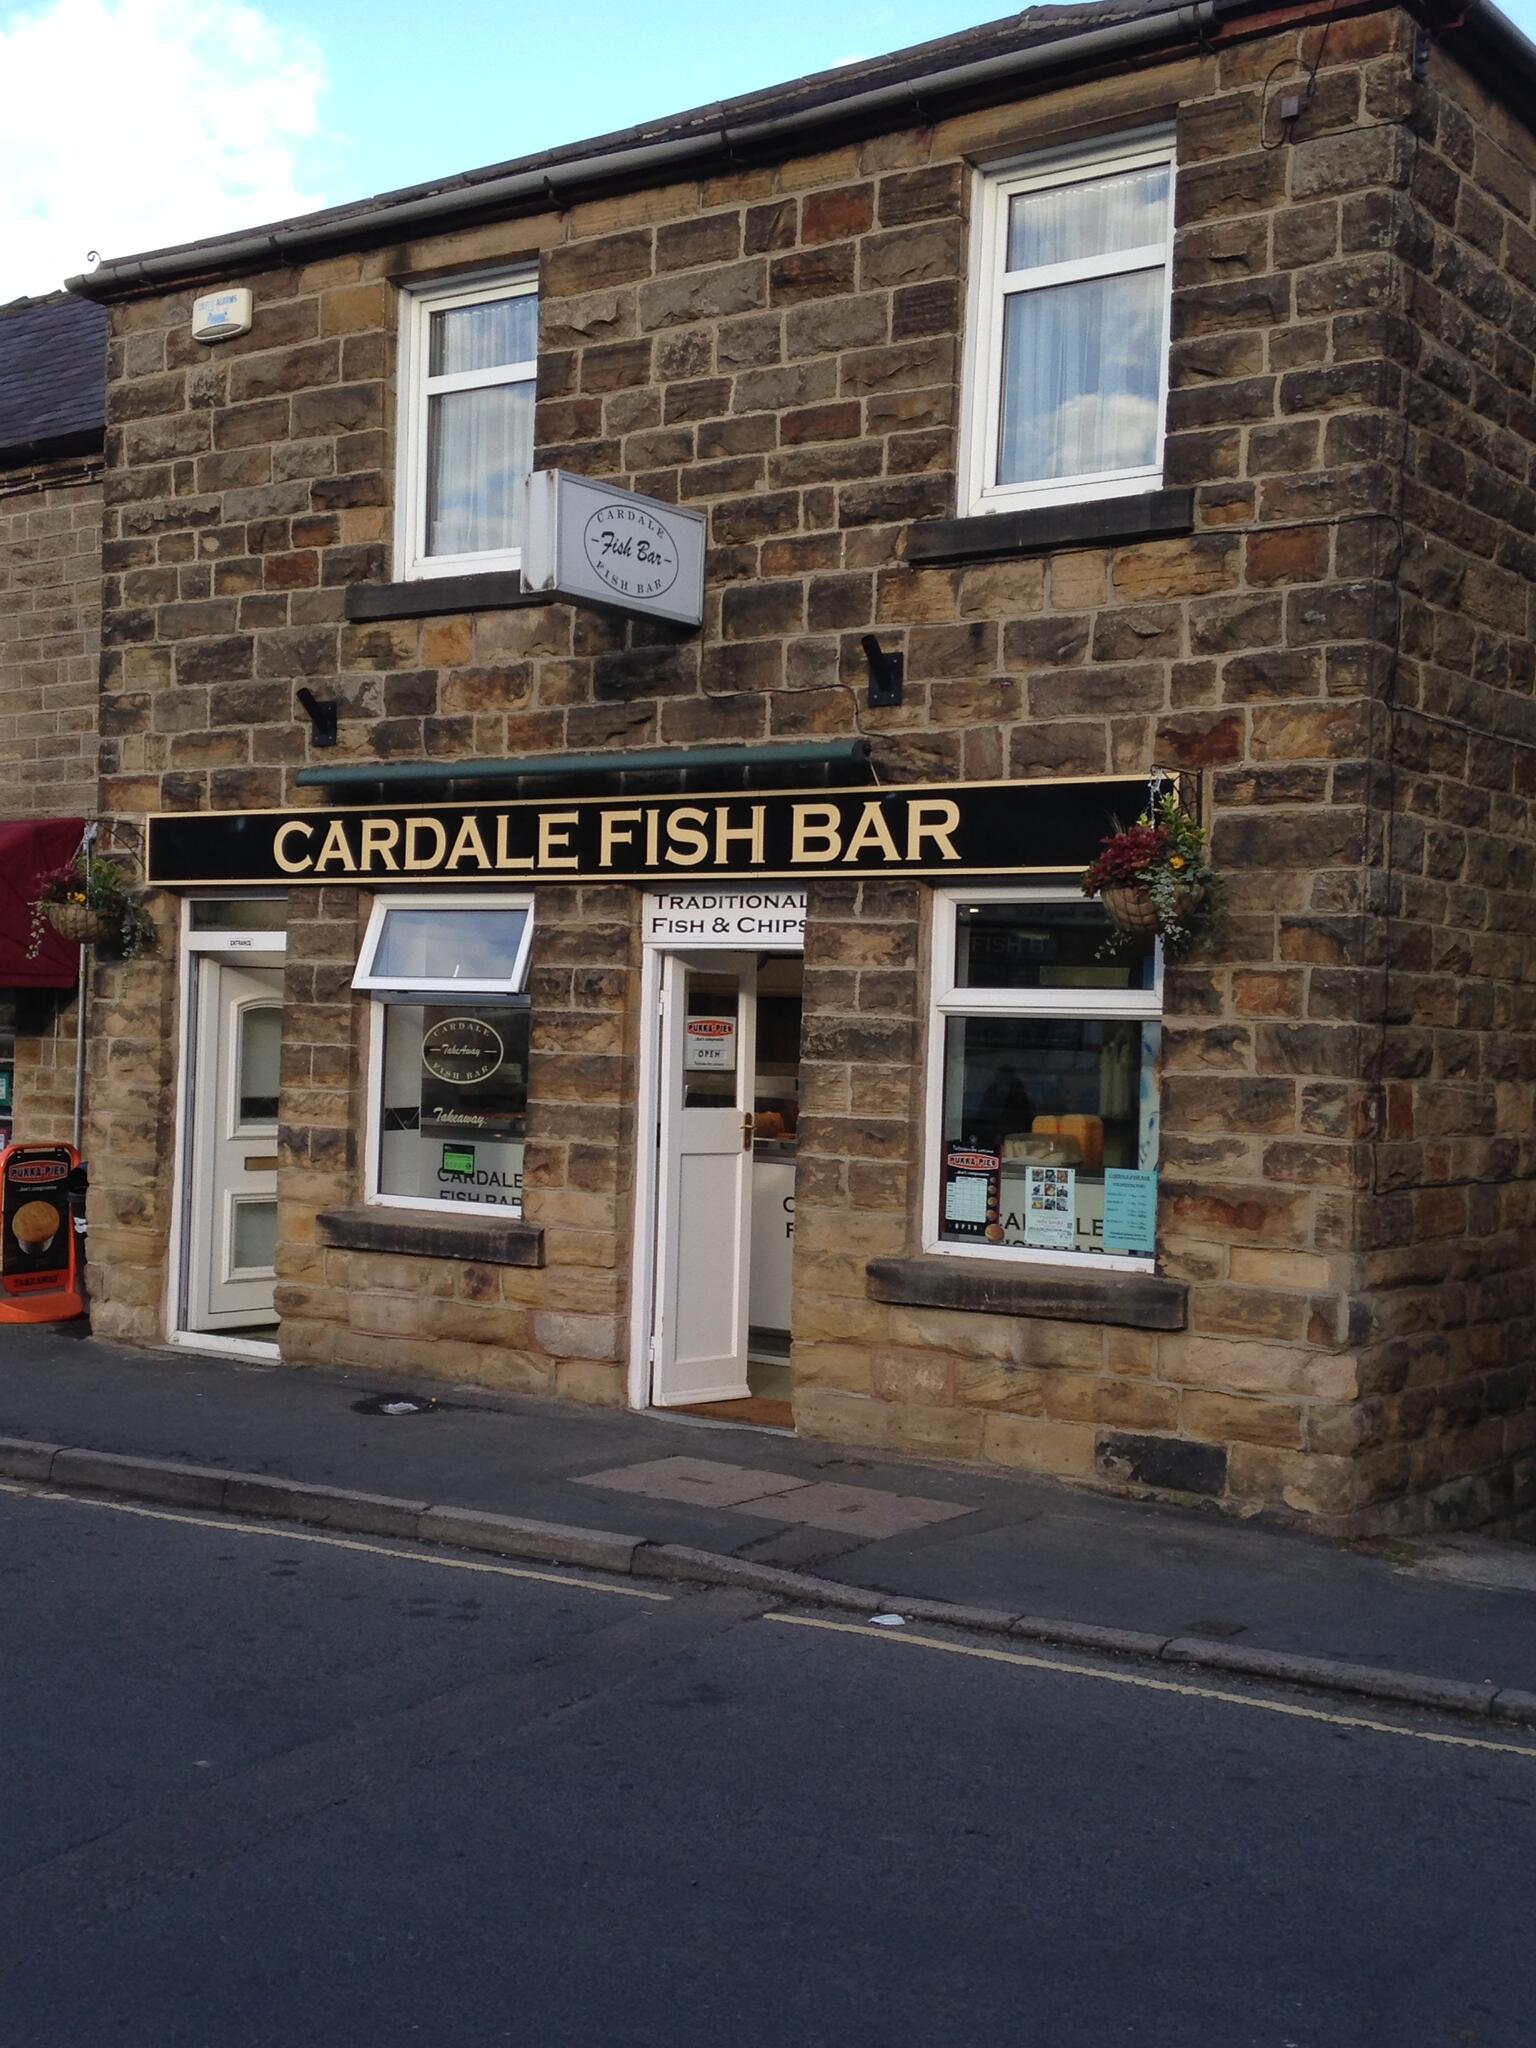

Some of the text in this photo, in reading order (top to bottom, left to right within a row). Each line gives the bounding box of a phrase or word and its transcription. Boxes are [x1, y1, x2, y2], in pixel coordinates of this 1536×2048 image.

[597, 509, 664, 539] CARDALE
[601, 531, 662, 566] Fish Bar
[596, 560, 662, 594] FISH BAR
[273, 799, 962, 874] CARDALE FISH BAR
[711, 917, 730, 934] &
[433, 1022, 489, 1037] CARDALE
[698, 1050, 720, 1058] OPEN
[433, 1062, 489, 1080] FISH BAR
